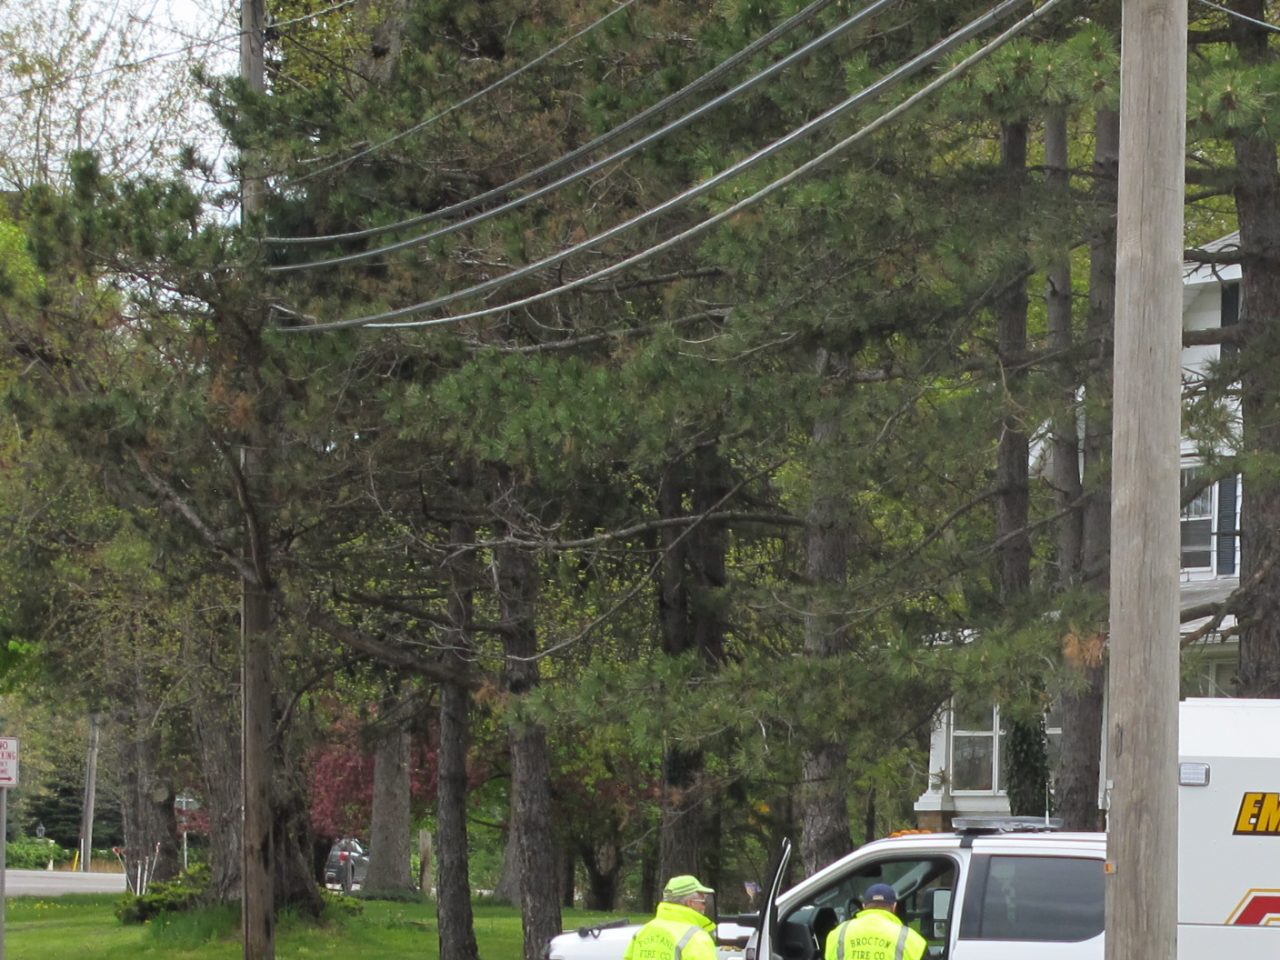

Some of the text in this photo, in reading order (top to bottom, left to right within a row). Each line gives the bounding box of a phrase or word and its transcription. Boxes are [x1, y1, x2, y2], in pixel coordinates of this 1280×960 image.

[850, 936, 892, 949] BROCTON
[640, 949, 657, 959] FIRE
[852, 950, 870, 960] FIRE
